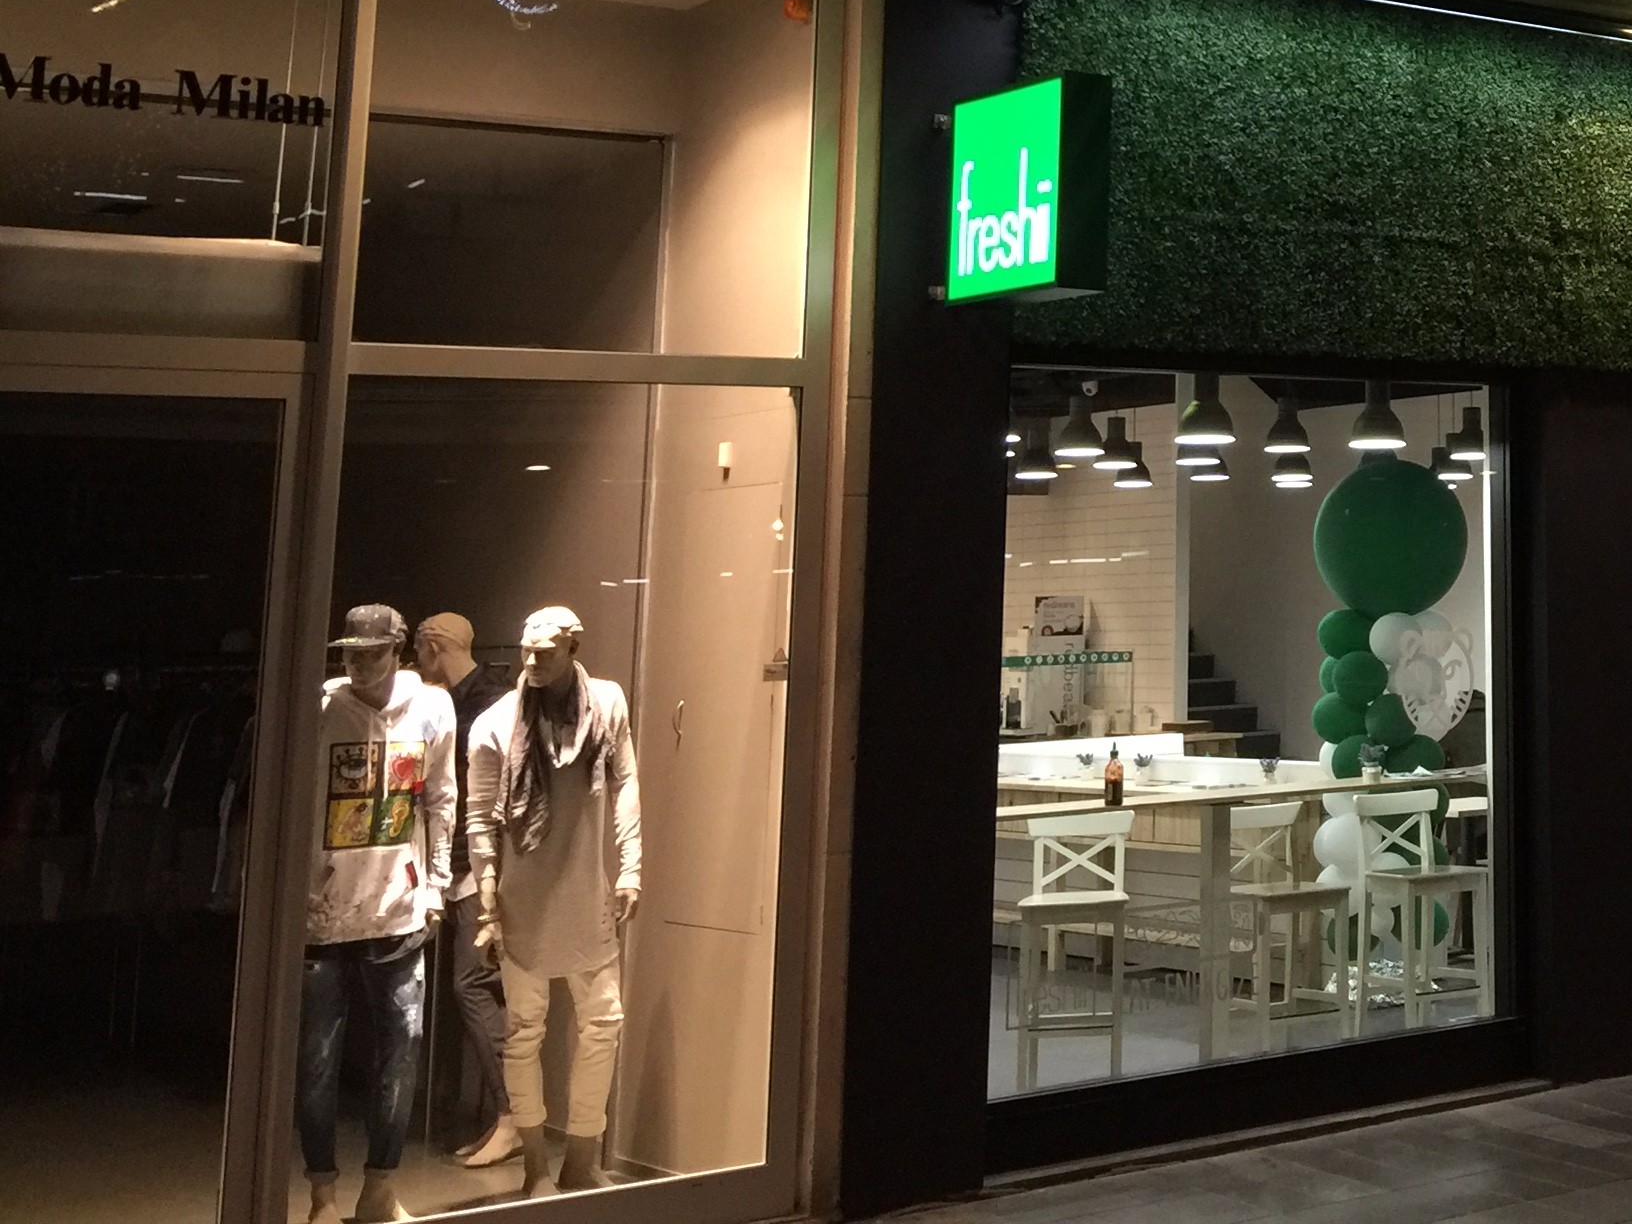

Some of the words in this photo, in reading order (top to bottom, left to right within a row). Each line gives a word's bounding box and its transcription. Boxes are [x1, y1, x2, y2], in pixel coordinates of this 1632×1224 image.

[0, 52, 143, 111] Moda
[171, 69, 325, 127] Milan
[956, 146, 1053, 277] freshii
